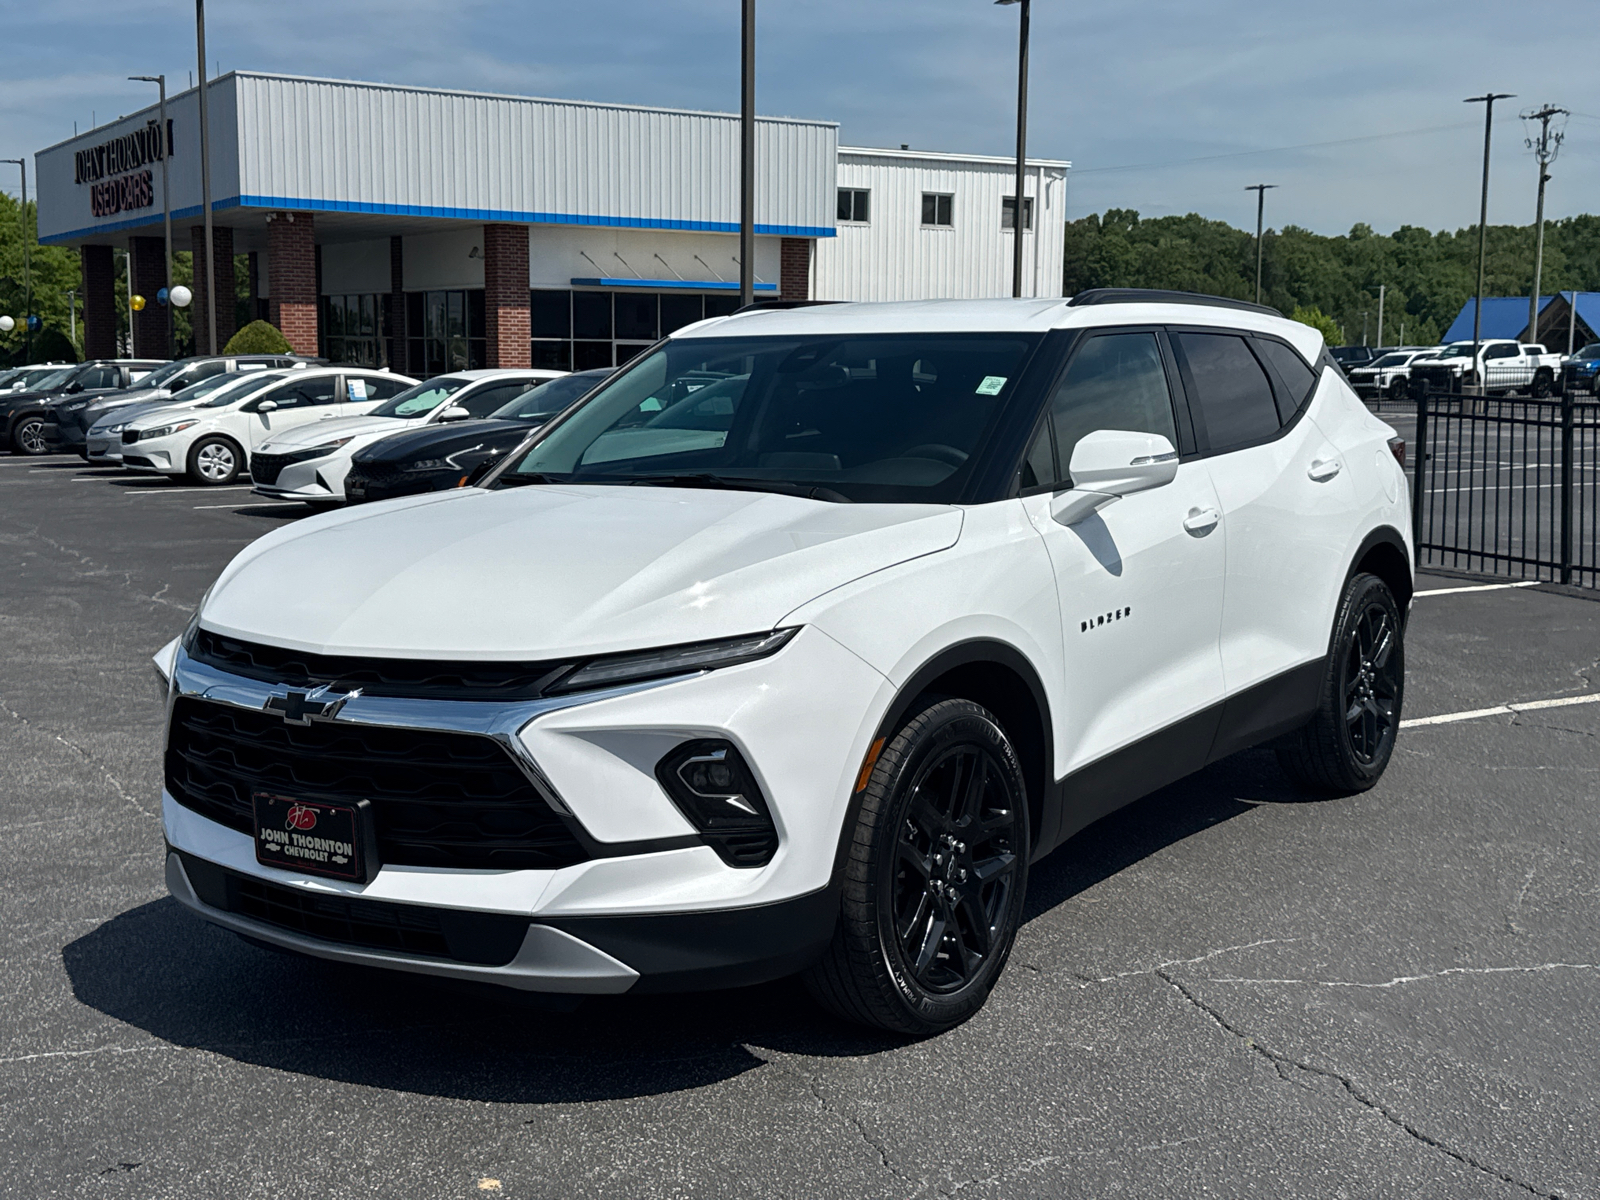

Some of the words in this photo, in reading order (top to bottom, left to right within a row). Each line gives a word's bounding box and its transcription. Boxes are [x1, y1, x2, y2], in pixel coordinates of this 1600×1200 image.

[74, 146, 104, 184] JOHN
[90, 179, 120, 217] USED
[119, 169, 154, 211] CARS
[1080, 606, 1131, 633] BLAZER
[260, 827, 290, 845] JOHN
[291, 832, 353, 857] THORNTON
[283, 845, 329, 863] CHEVROLET
[894, 970, 917, 1004] PRIMACY
